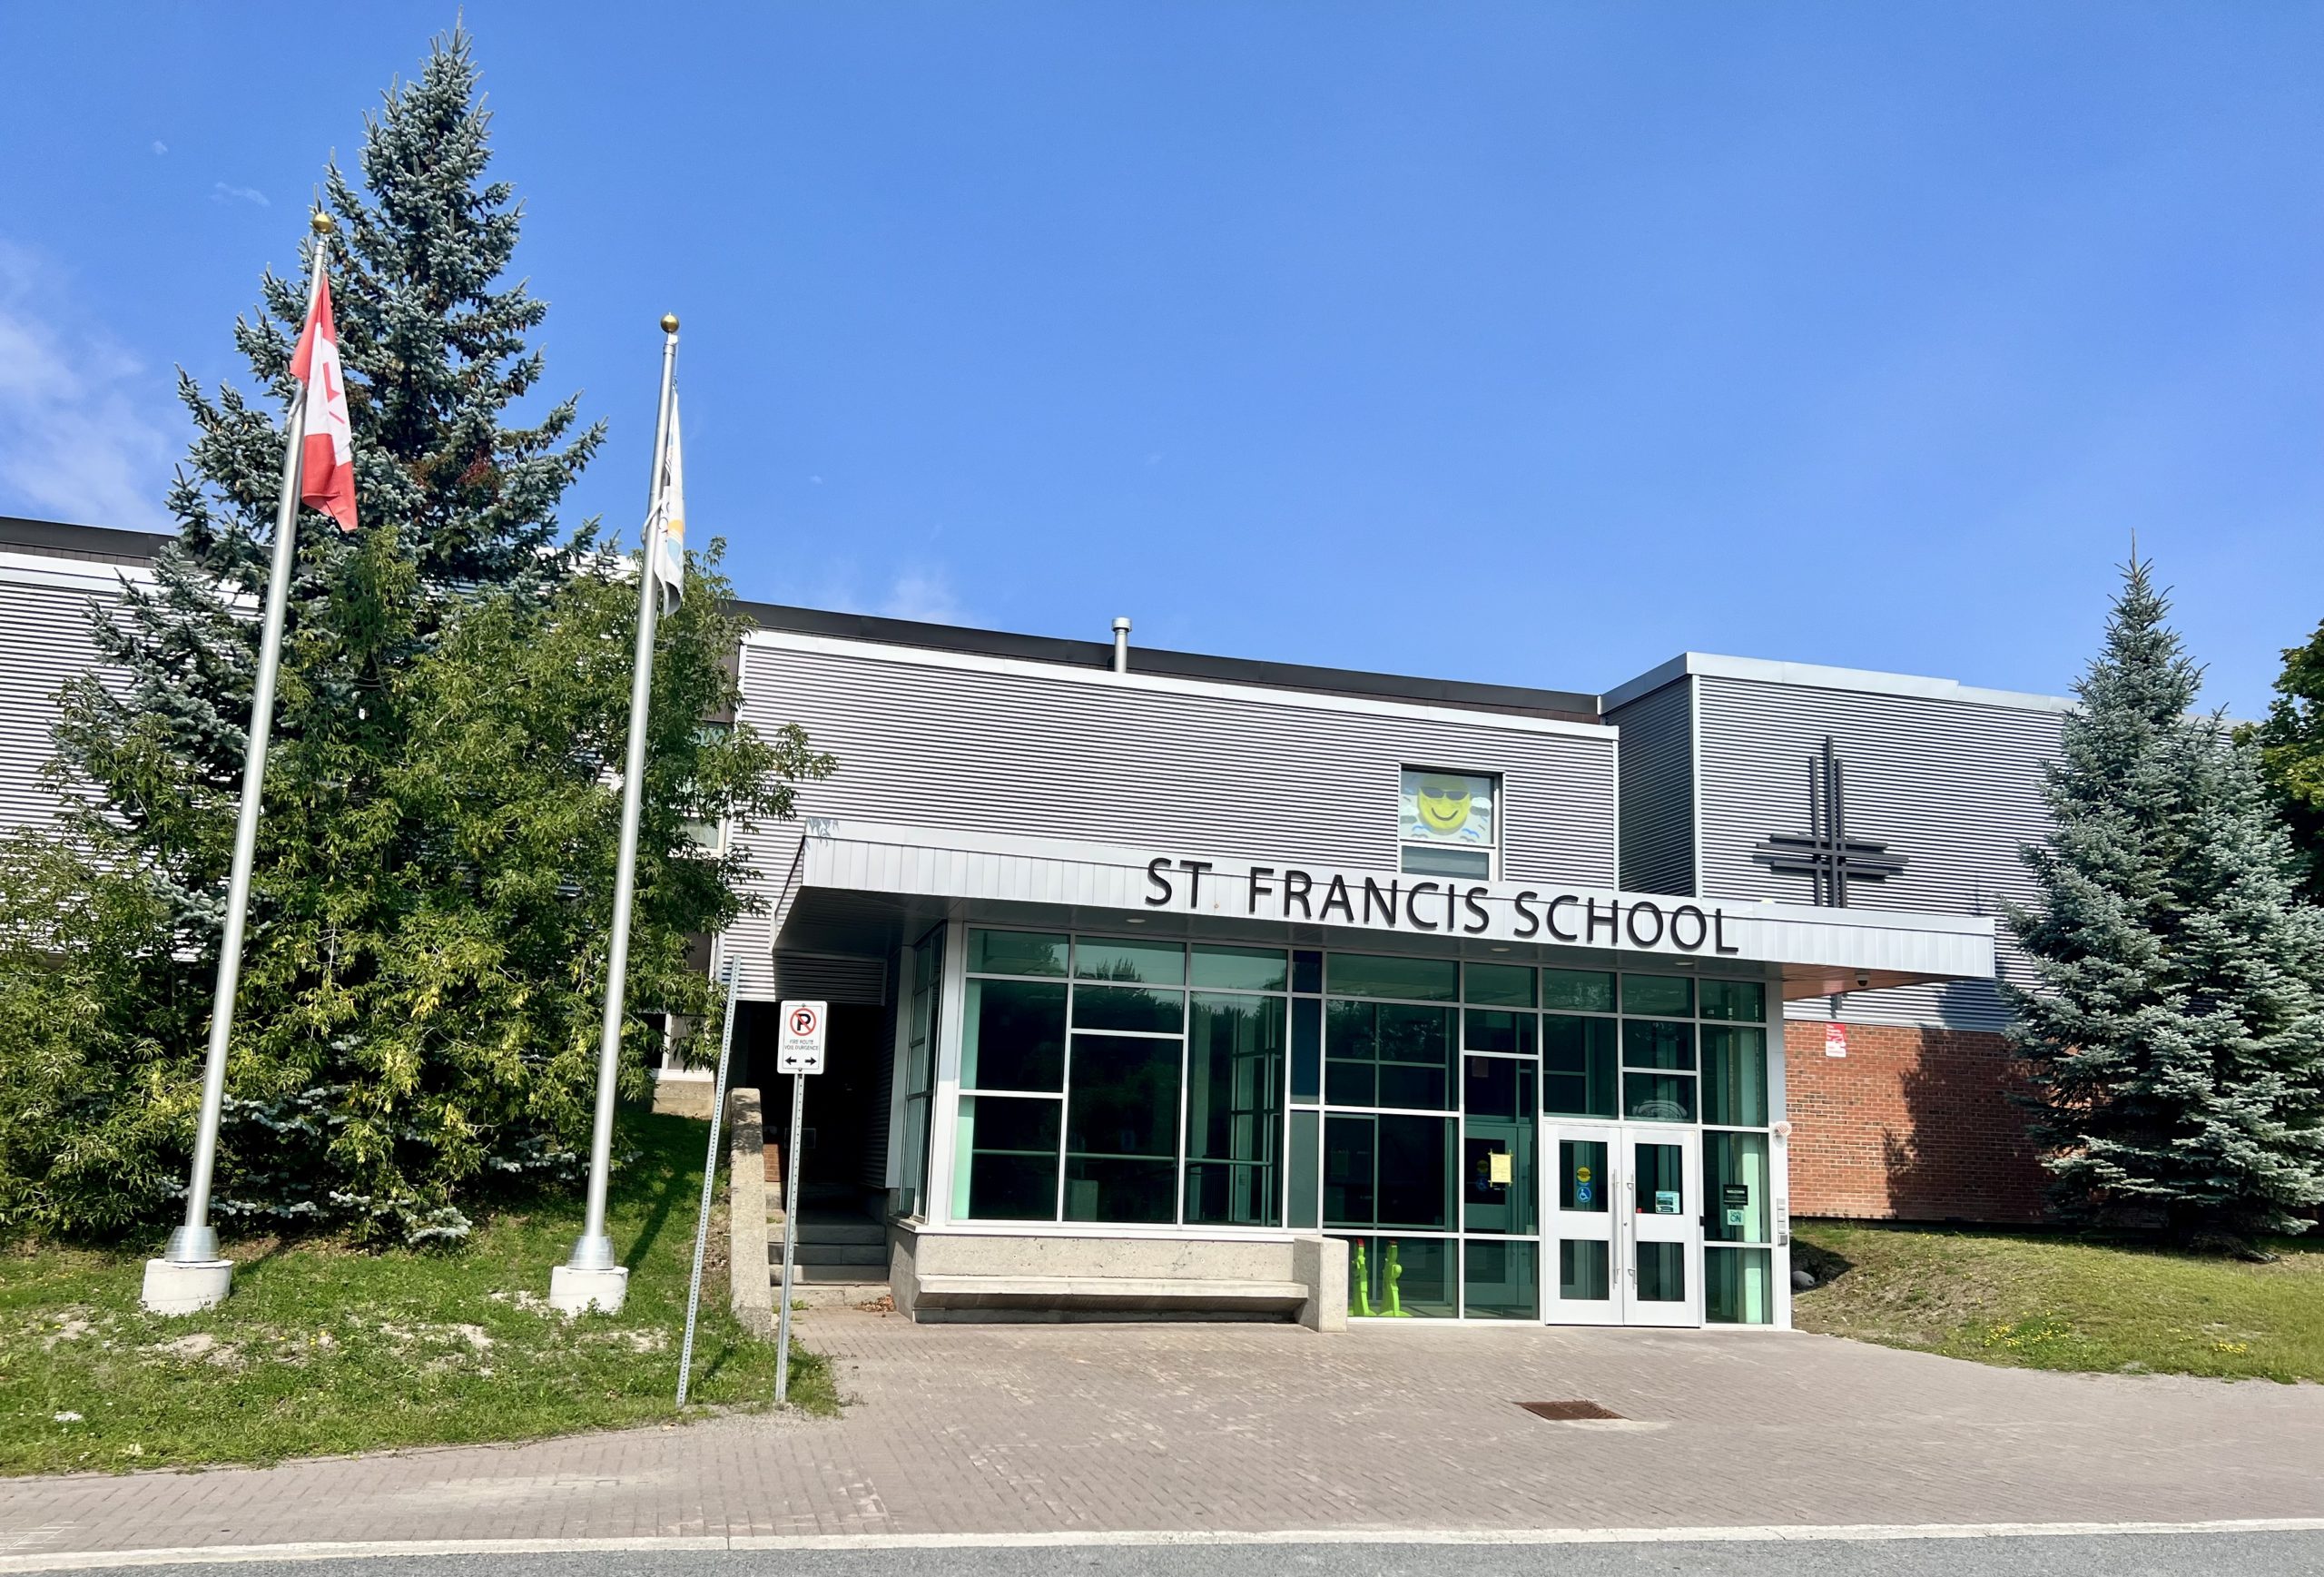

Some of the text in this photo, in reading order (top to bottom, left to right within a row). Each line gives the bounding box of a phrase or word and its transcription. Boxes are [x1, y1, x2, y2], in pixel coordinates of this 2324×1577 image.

[1145, 857, 1738, 953] ST FRANCIS SCHOOL
[797, 1013, 811, 1030] P
